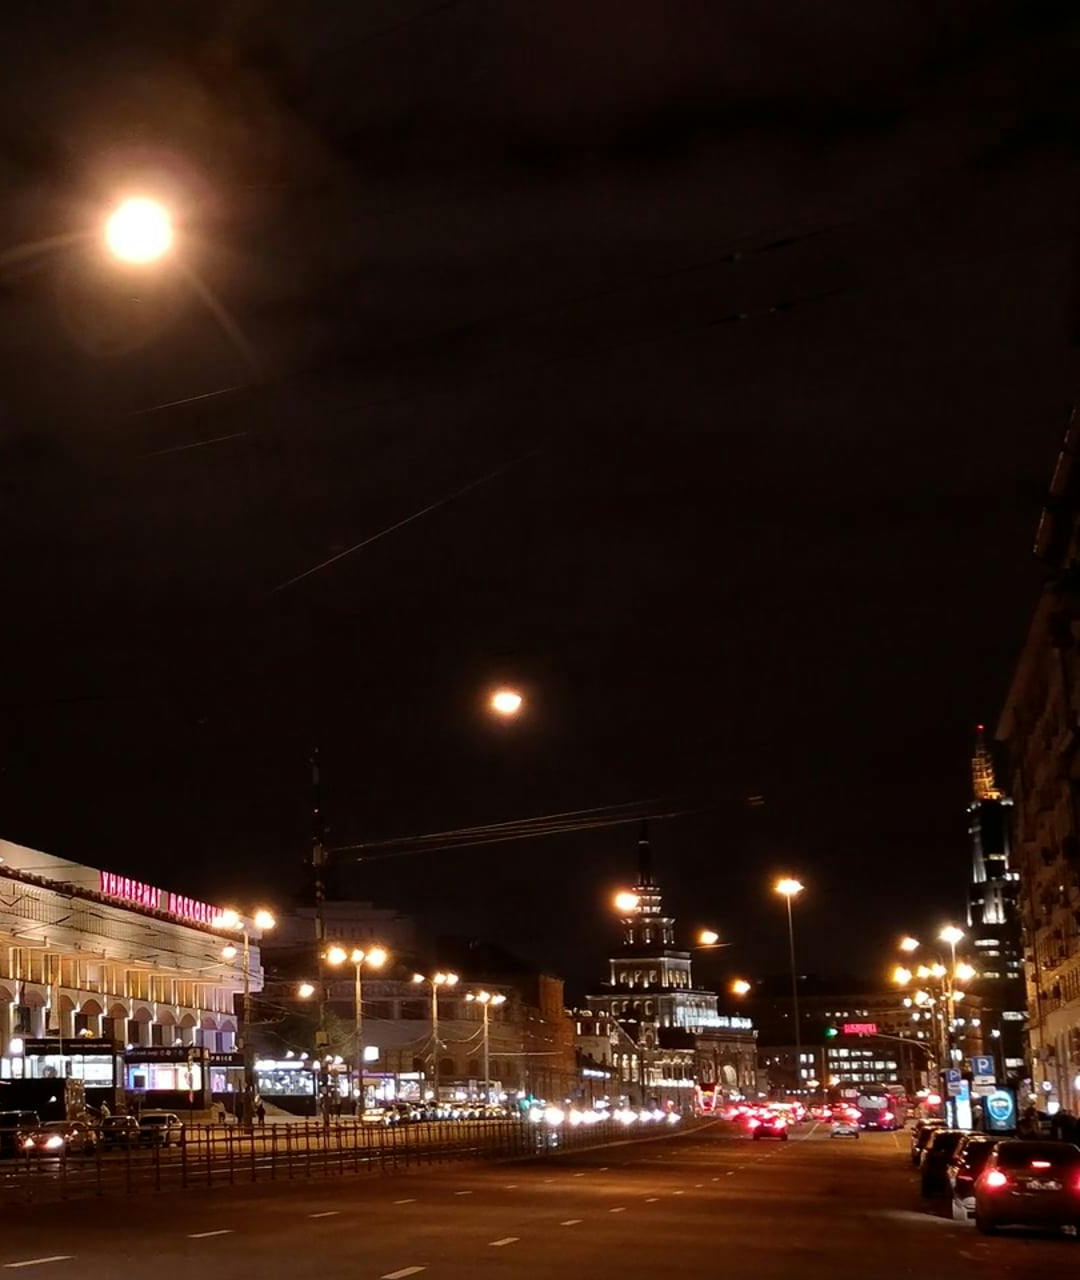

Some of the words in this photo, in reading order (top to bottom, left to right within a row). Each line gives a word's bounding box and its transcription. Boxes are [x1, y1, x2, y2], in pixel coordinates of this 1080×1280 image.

[102, 871, 162, 910] УНИВЕРМАГ
[170, 892, 223, 926] МОСКОВСКИ
[977, 1059, 989, 1073] P
